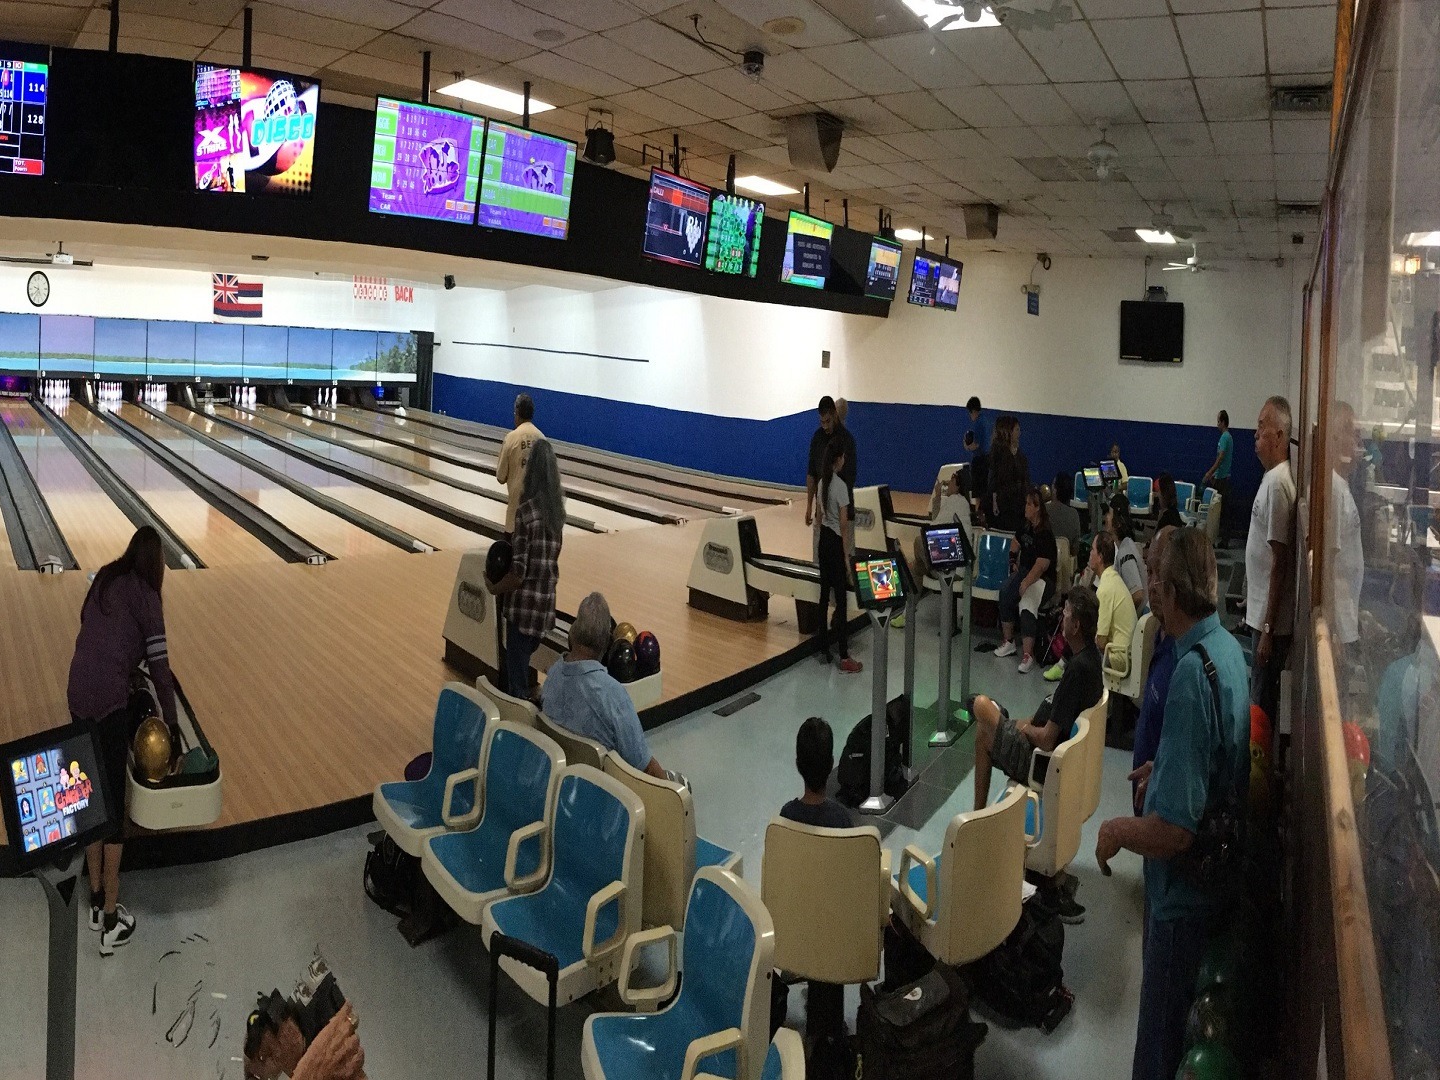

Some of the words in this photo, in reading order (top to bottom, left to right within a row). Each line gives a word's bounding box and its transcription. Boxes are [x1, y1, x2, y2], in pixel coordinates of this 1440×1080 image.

[28, 82, 45, 93] 114
[27, 114, 44, 125] 128
[250, 113, 314, 147] DISCO
[394, 286, 414, 303] BACK
[62, 798, 90, 816] FACTORY
